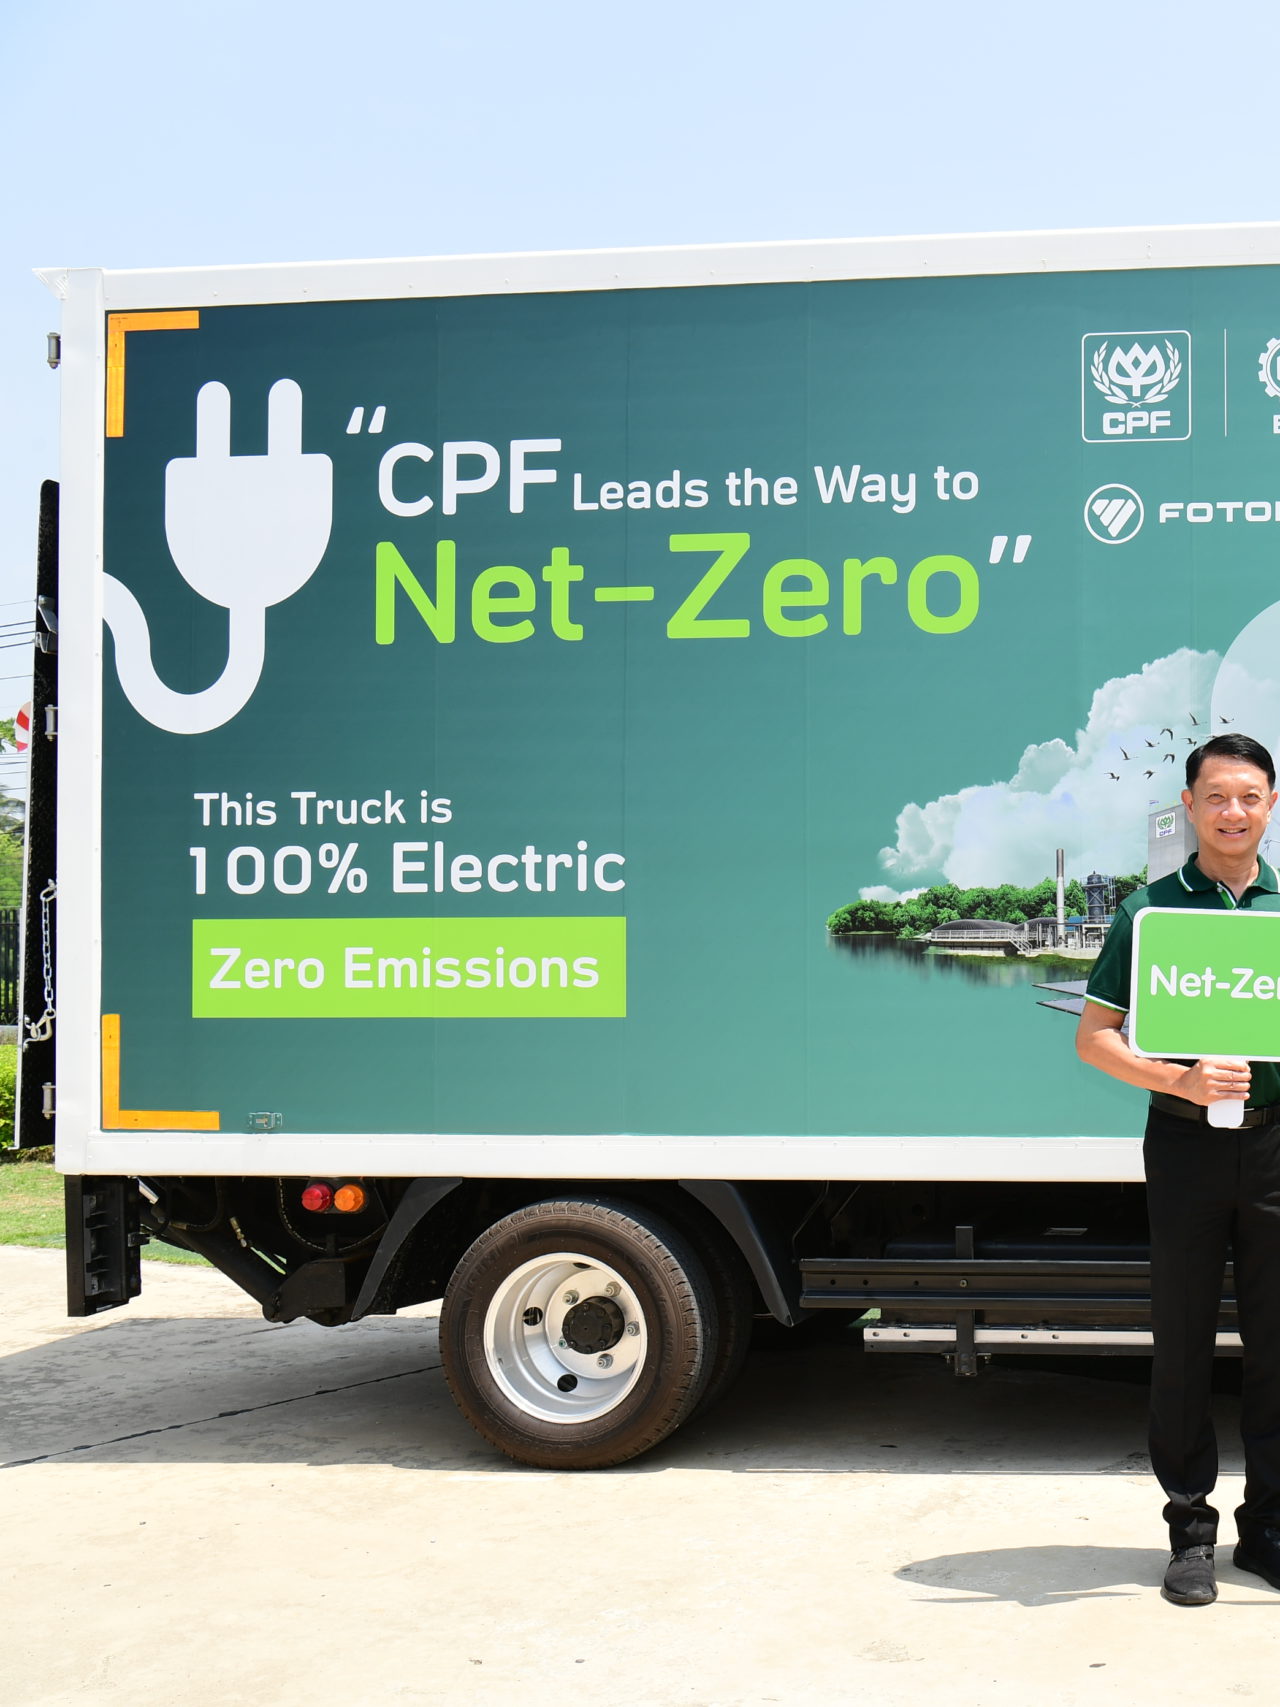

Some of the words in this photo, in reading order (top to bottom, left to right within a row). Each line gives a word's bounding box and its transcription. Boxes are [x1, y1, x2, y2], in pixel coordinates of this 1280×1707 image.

[1102, 410, 1171, 435] CPF
[573, 469, 709, 511] Leads
[725, 467, 799, 507] the
[813, 464, 917, 514] Way
[933, 465, 980, 501] to
[193, 792, 277, 826] This
[290, 790, 407, 825] Truck
[420, 790, 453, 824] is
[189, 842, 368, 895] 100%
[392, 840, 626, 893] Electric
[208, 947, 325, 989] Zero
[344, 946, 600, 988] Emissions
